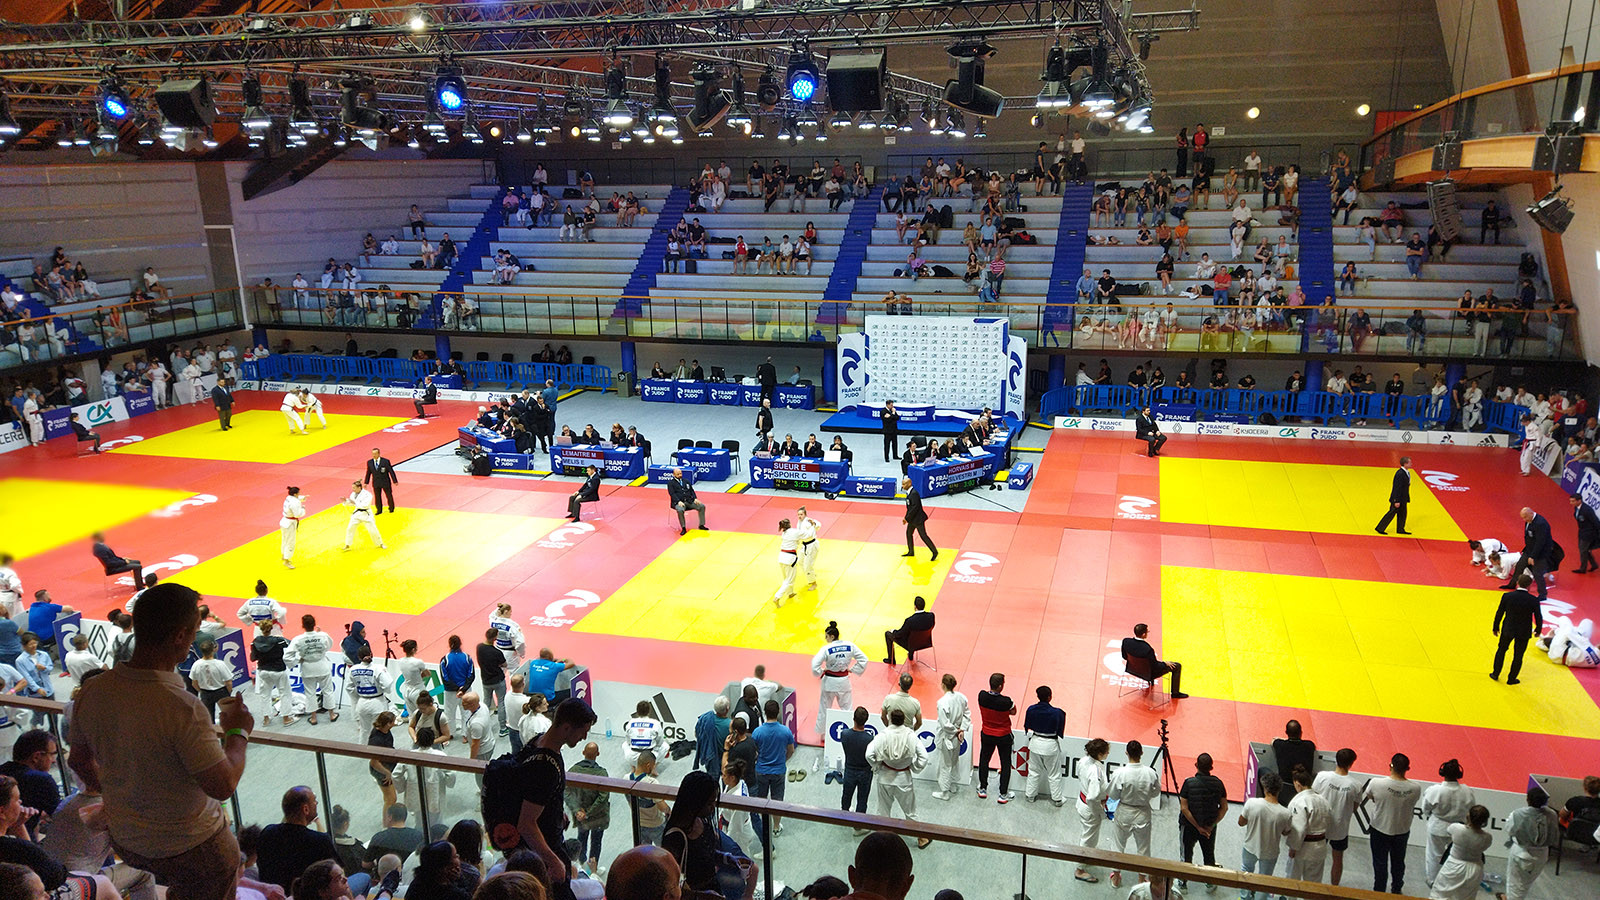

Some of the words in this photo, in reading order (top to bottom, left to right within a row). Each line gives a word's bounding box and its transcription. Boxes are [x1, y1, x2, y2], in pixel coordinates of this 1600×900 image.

[605, 459, 630, 467] FRANCE
[773, 462, 799, 471] SUEUR
[773, 470, 800, 479] SPOHR
[801, 472, 807, 480] C
